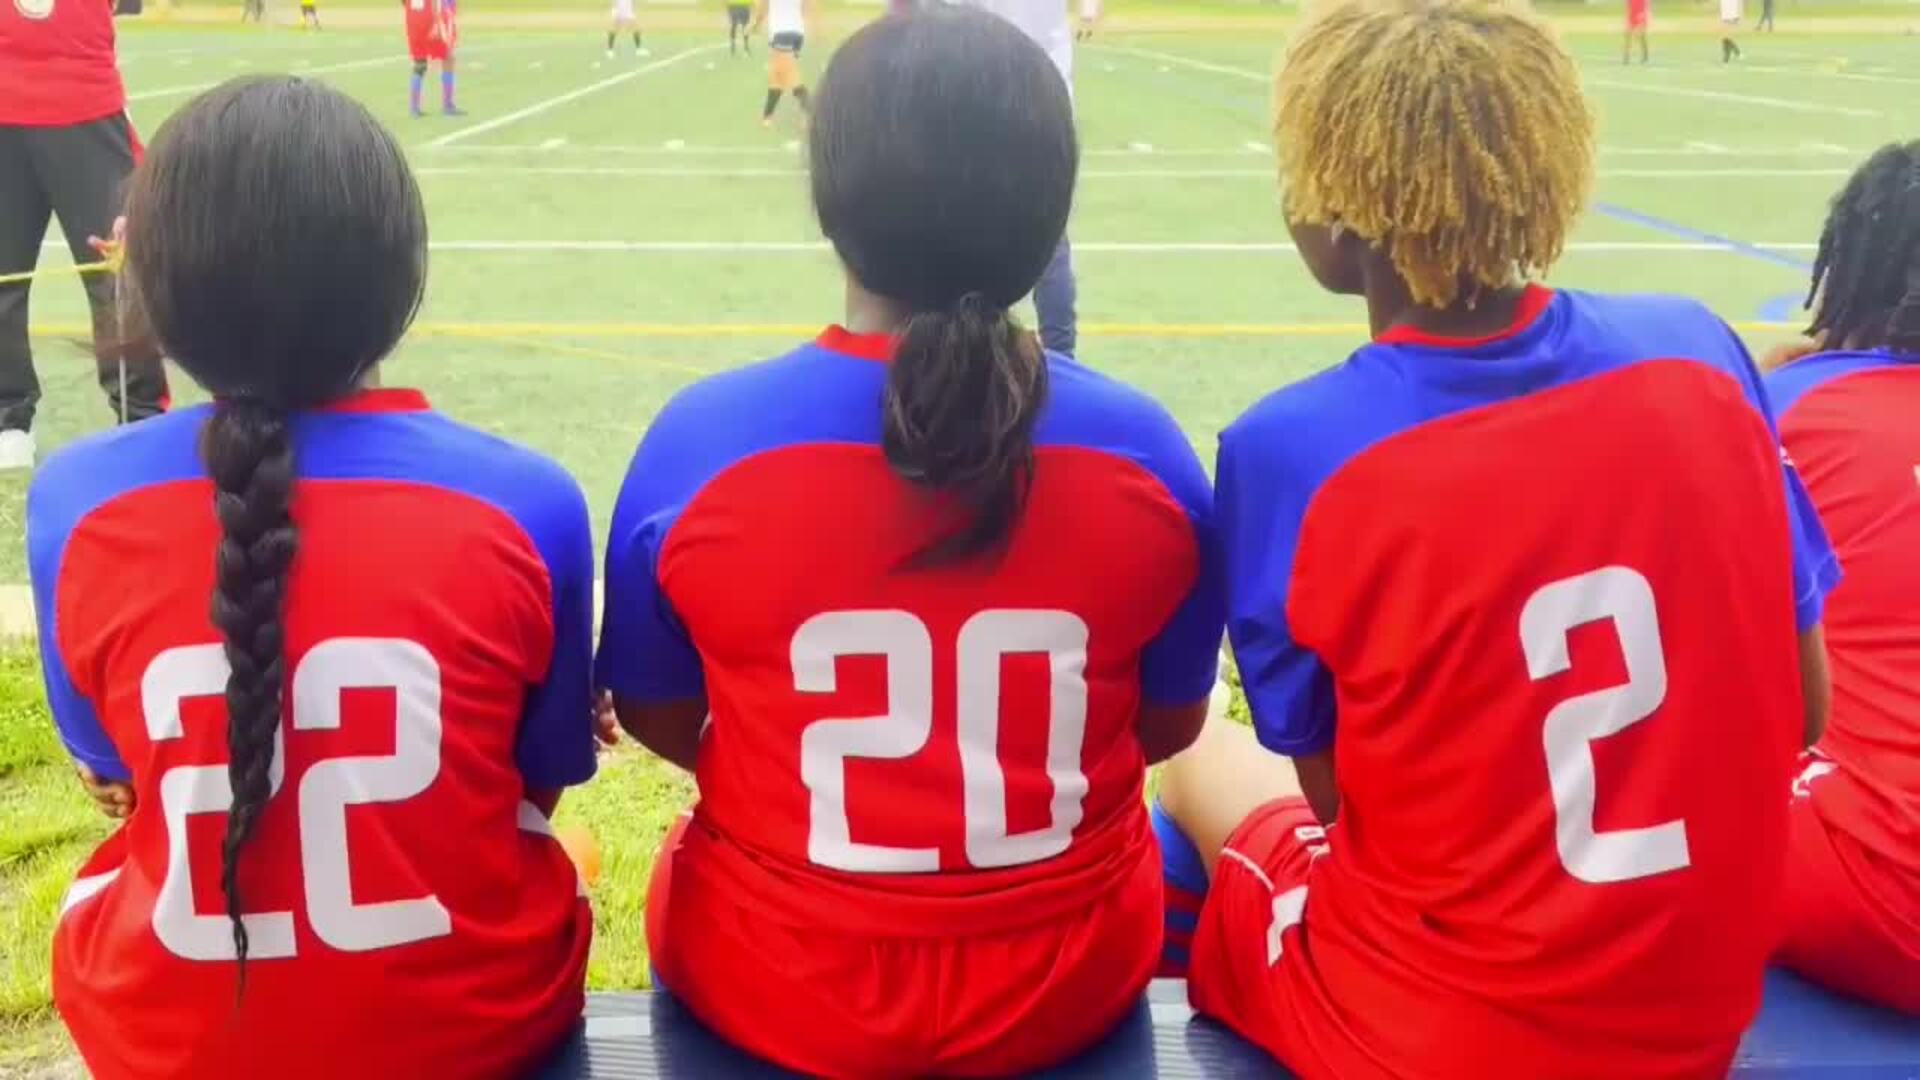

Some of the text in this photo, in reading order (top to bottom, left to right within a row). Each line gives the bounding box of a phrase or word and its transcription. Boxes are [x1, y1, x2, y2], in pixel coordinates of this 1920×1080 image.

[141, 636, 452, 960] 22
[790, 609, 1088, 872] 20
[1520, 566, 1690, 883] 2
